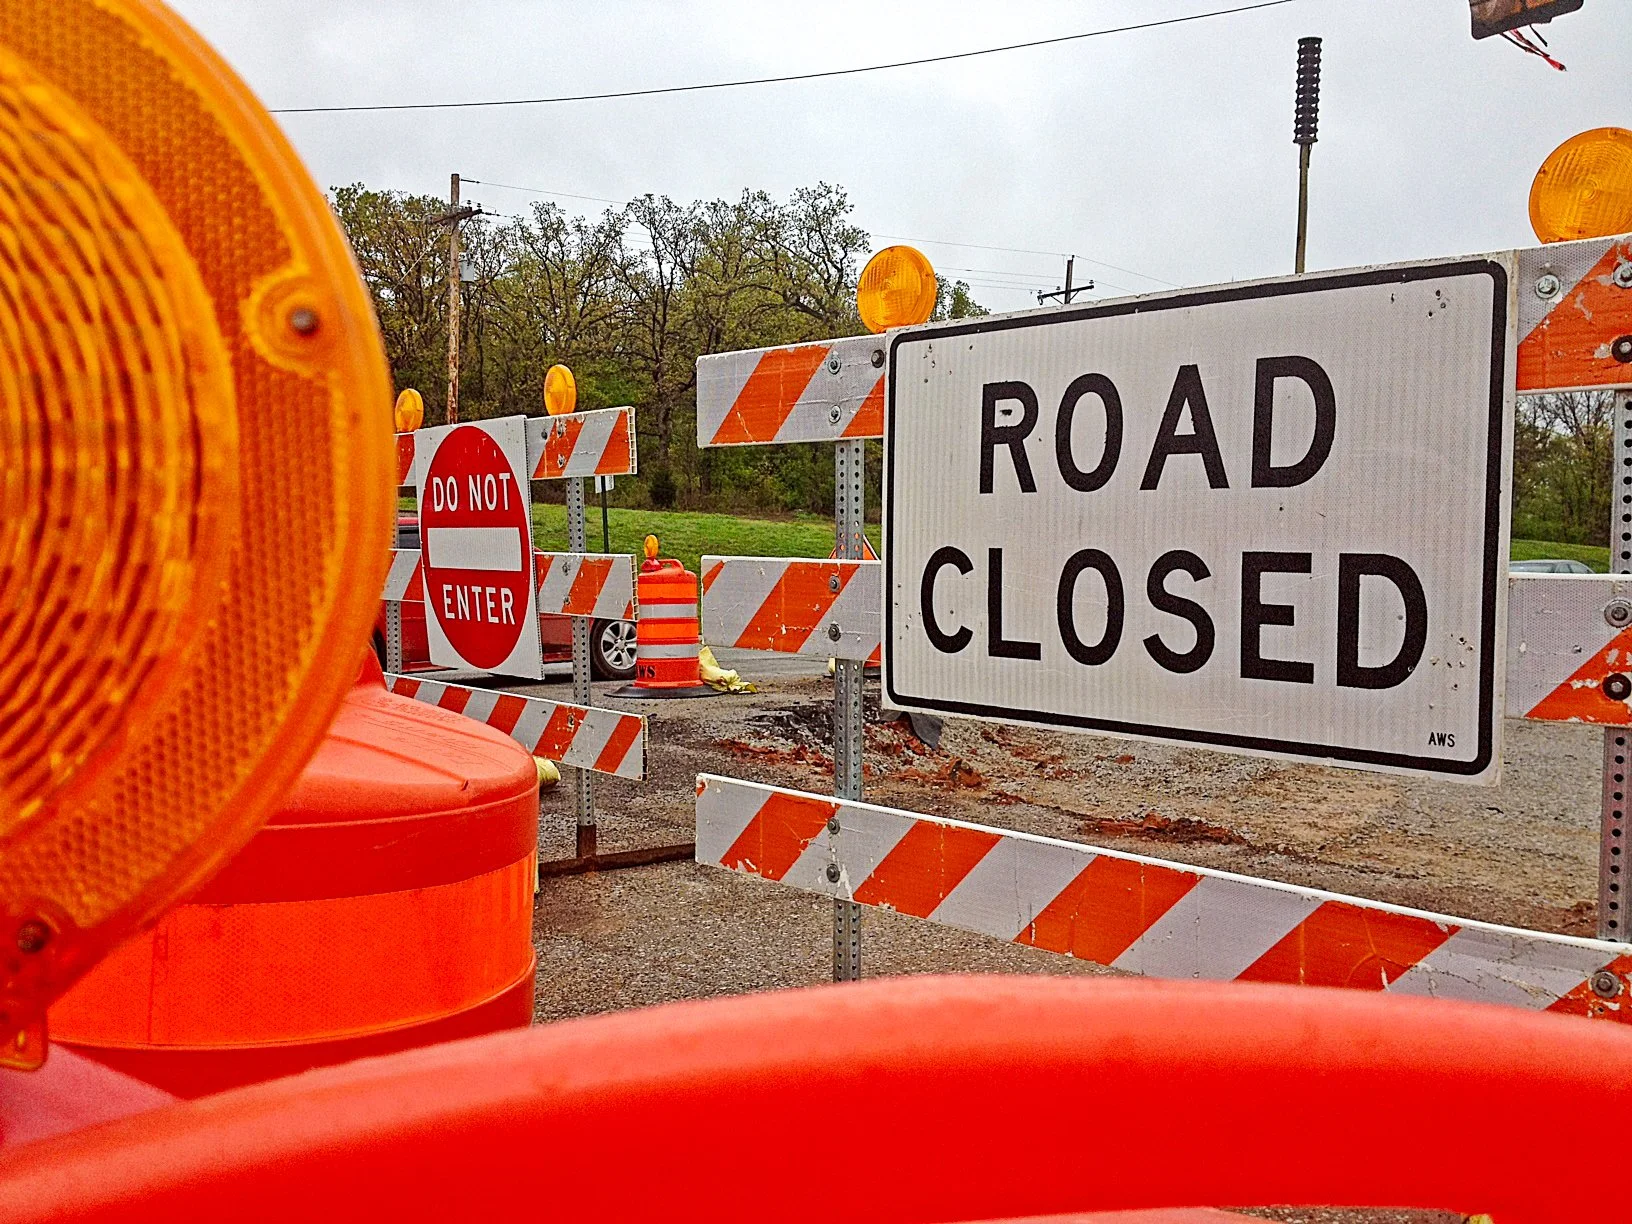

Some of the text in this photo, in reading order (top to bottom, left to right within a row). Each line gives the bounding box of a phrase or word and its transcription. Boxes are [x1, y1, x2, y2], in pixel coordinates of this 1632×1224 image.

[979, 355, 1336, 494] ROAD
[432, 473, 511, 512] DO NOT
[442, 584, 515, 625] ENTER
[920, 546, 1428, 689] CLOSED
[1428, 731, 1456, 748] AWS
